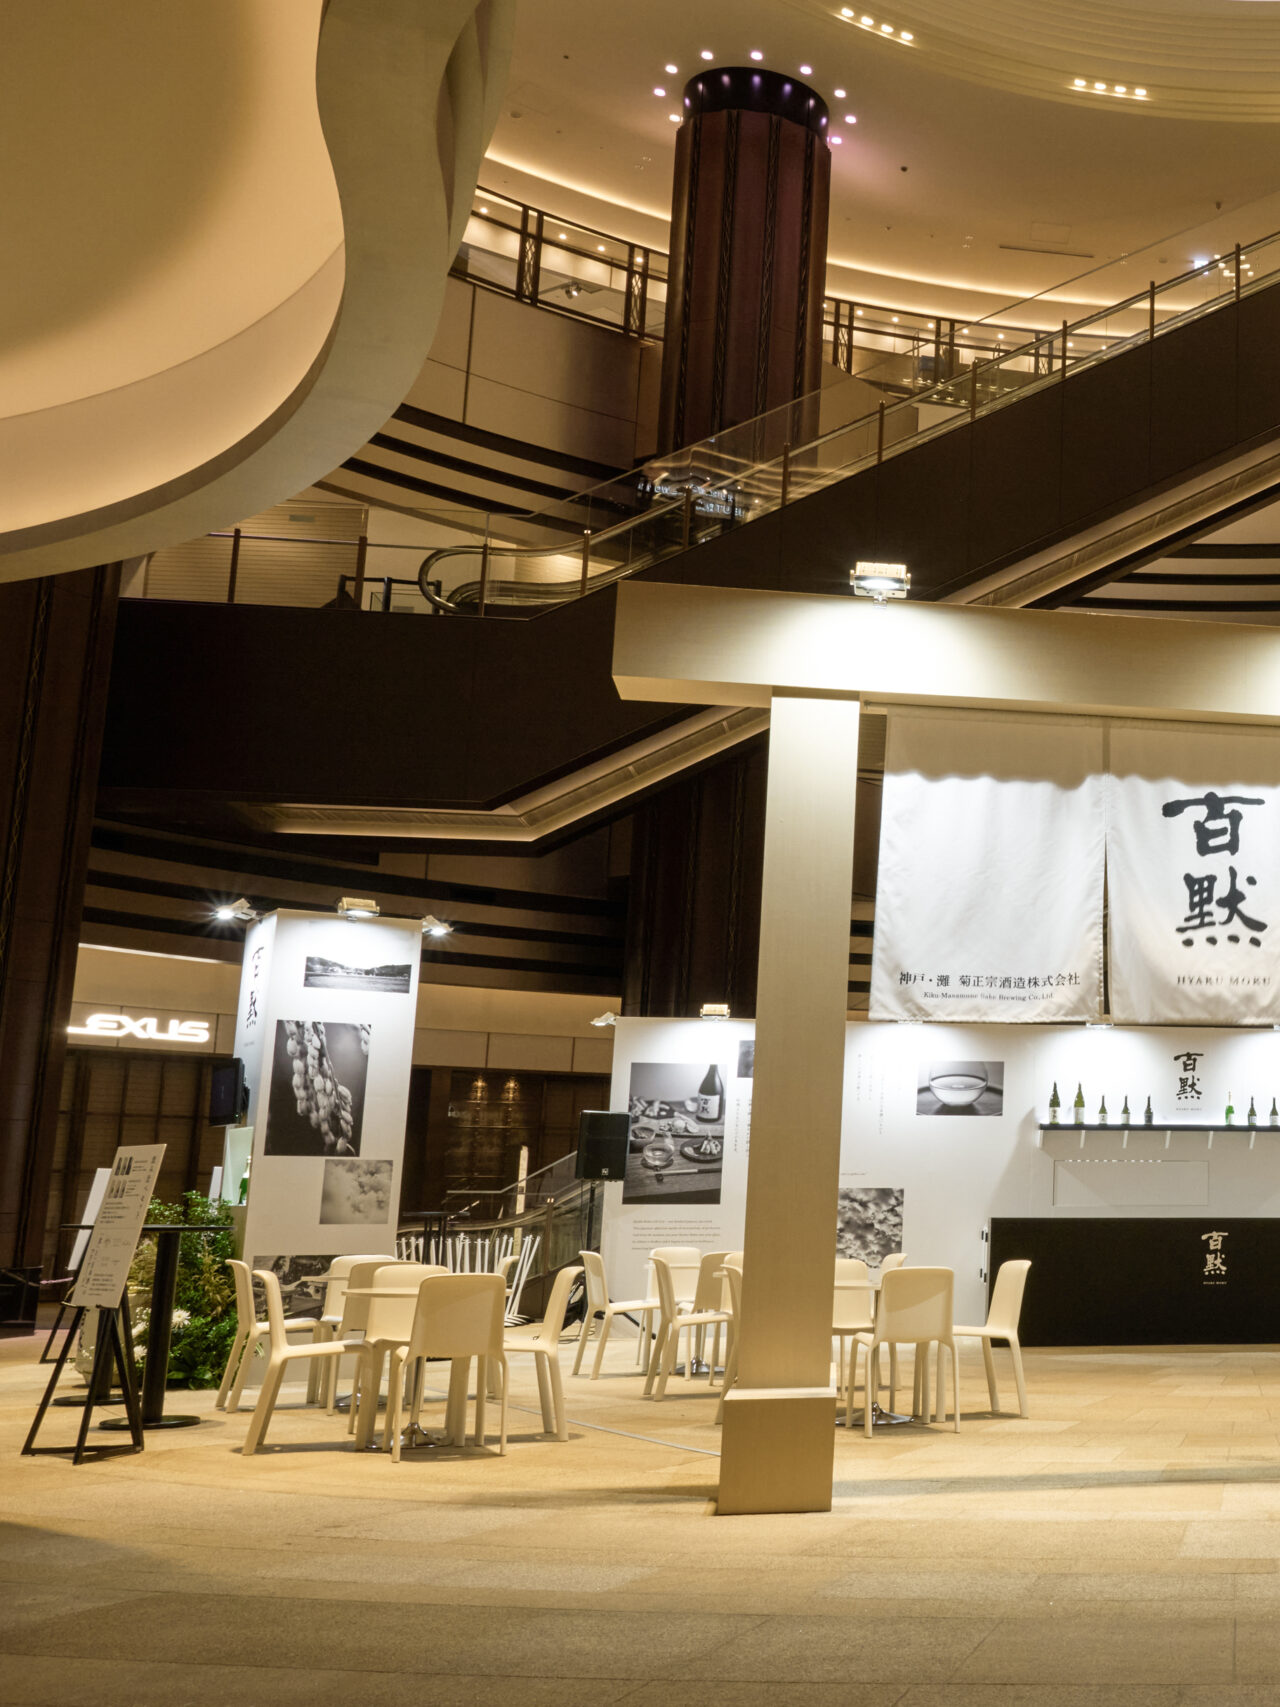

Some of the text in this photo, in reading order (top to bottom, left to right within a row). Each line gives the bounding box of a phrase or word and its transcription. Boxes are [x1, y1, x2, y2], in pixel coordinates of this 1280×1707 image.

[1162, 791, 1268, 948] 百黙
[899, 971, 1081, 989] 神戸・灘 菊正宗酒造株式会社
[1173, 1051, 1204, 1101] 百黙
[1201, 1231, 1229, 1275] 百黙
